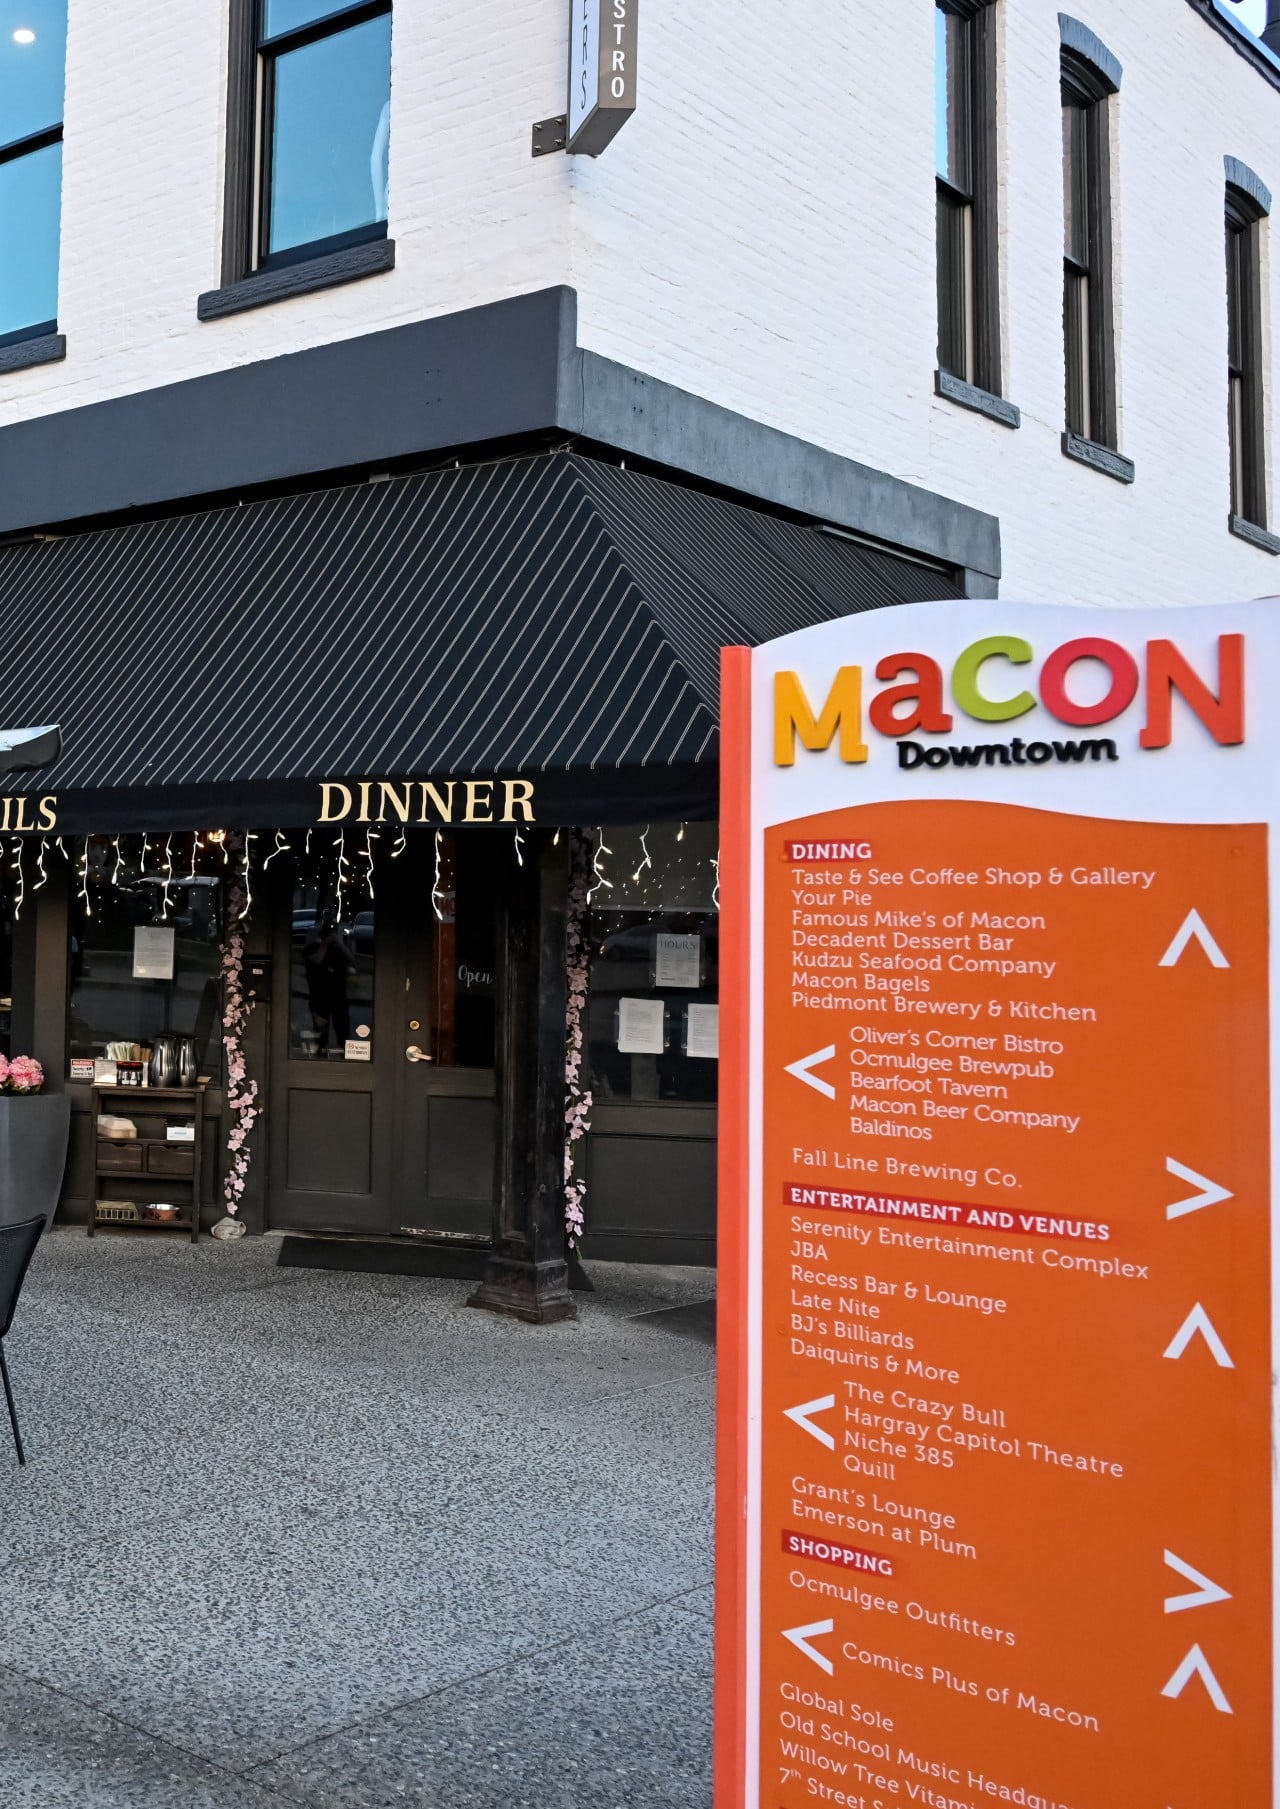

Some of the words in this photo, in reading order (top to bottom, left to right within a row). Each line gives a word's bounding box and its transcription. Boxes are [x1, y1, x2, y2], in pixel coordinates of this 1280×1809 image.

[896, 737, 1119, 770] Downtown
[316, 780, 536, 823] DINNER
[791, 842, 872, 860] DINING
[791, 869, 843, 885] Taste
[849, 868, 862, 885] &
[868, 868, 904, 885] See
[910, 868, 979, 885] Coffee
[985, 867, 1042, 889] Shop
[1048, 867, 1064, 885] &
[1070, 867, 1156, 889] Gallery
[792, 889, 836, 906] Your
[843, 889, 872, 906] Pie
[792, 909, 868, 927] Famous
[875, 911, 936, 928] Mike's
[942, 911, 964, 928] of
[970, 911, 1046, 929] Macon
[660, 939, 698, 951] HOURS
[792, 930, 885, 948] Decadent
[893, 932, 971, 950] Dessert
[978, 933, 1013, 951] Bar
[458, 964, 494, 988] Open
[792, 951, 852, 968] Kudzu
[859, 952, 942, 971] Seafood
[948, 954, 1057, 979] Company
[791, 971, 857, 989] Macon
[864, 973, 930, 995] Bagels
[792, 991, 887, 1011] Piedmont
[894, 995, 982, 1020] Brewery
[988, 999, 1003, 1017] &
[1009, 1000, 1097, 1022] Kitchen
[850, 1026, 920, 1046] Oliver's
[925, 1030, 997, 1050] Corner
[1004, 1034, 1064, 1055] Bistro
[850, 1048, 953, 1074] Ocmulgee
[959, 1055, 1054, 1080] Brewpub
[850, 1071, 932, 1093] Bearfoot
[937, 1077, 1008, 1099] Tavern
[850, 1094, 916, 1115] Macon
[923, 1099, 969, 1119] Beer
[973, 1104, 1081, 1134] Company
[850, 1116, 933, 1141] Baldinos
[792, 1147, 827, 1167] Fall
[834, 1152, 879, 1172] Line
[886, 1157, 978, 1187] Brewing
[984, 1167, 1023, 1187] Co.
[791, 1187, 962, 1222] ENTERTAINMENT
[966, 1209, 1014, 1229] AND
[1019, 1214, 1110, 1241] VENUES
[790, 1240, 828, 1261] JBA
[791, 1215, 872, 1246] Serenity
[878, 1227, 1035, 1264] Entertainment
[1041, 1248, 1148, 1279] Complex
[791, 1264, 858, 1290] Recess
[864, 1275, 898, 1296] Bar
[904, 1281, 918, 1299] &
[924, 1284, 1007, 1315] Lounge
[791, 1289, 832, 1311] Late
[839, 1297, 880, 1319] Nite
[791, 1313, 827, 1335] BJ's
[834, 1320, 914, 1350] Billiards
[791, 1338, 879, 1369] Daiquiris
[885, 1355, 900, 1373] &
[905, 1359, 960, 1384] More
[843, 1381, 884, 1404] The
[891, 1390, 954, 1421] Crazy
[962, 1403, 1005, 1428] Bull
[844, 1405, 930, 1441] Hargray
[937, 1424, 1020, 1457] Capitol
[1027, 1441, 1124, 1478] Theatre
[844, 1430, 907, 1458] Niche
[915, 1444, 954, 1468] 385
[844, 1454, 895, 1481] Quill
[791, 1476, 865, 1508] Grant's
[872, 1494, 956, 1530] Lounge
[792, 1498, 884, 1537] Emerson
[891, 1527, 911, 1543] at
[919, 1529, 977, 1560] Plum
[789, 1536, 893, 1576] SHOPPING
[789, 1570, 899, 1614] Ocmulgee
[905, 1601, 1016, 1646] Outfitters
[842, 1642, 924, 1680] Comics
[932, 1666, 978, 1696] Plus
[986, 1687, 1009, 1705] of
[1017, 1692, 1099, 1732] Macon
[780, 1682, 844, 1716] Global
[850, 1703, 894, 1732] Sole
[780, 1711, 814, 1736] Old
[821, 1723, 890, 1761] School
[897, 1748, 960, 1784] Music
[780, 1738, 848, 1775] Willow
[853, 1763, 899, 1794] Tree
[807, 1777, 865, 1809] Street
